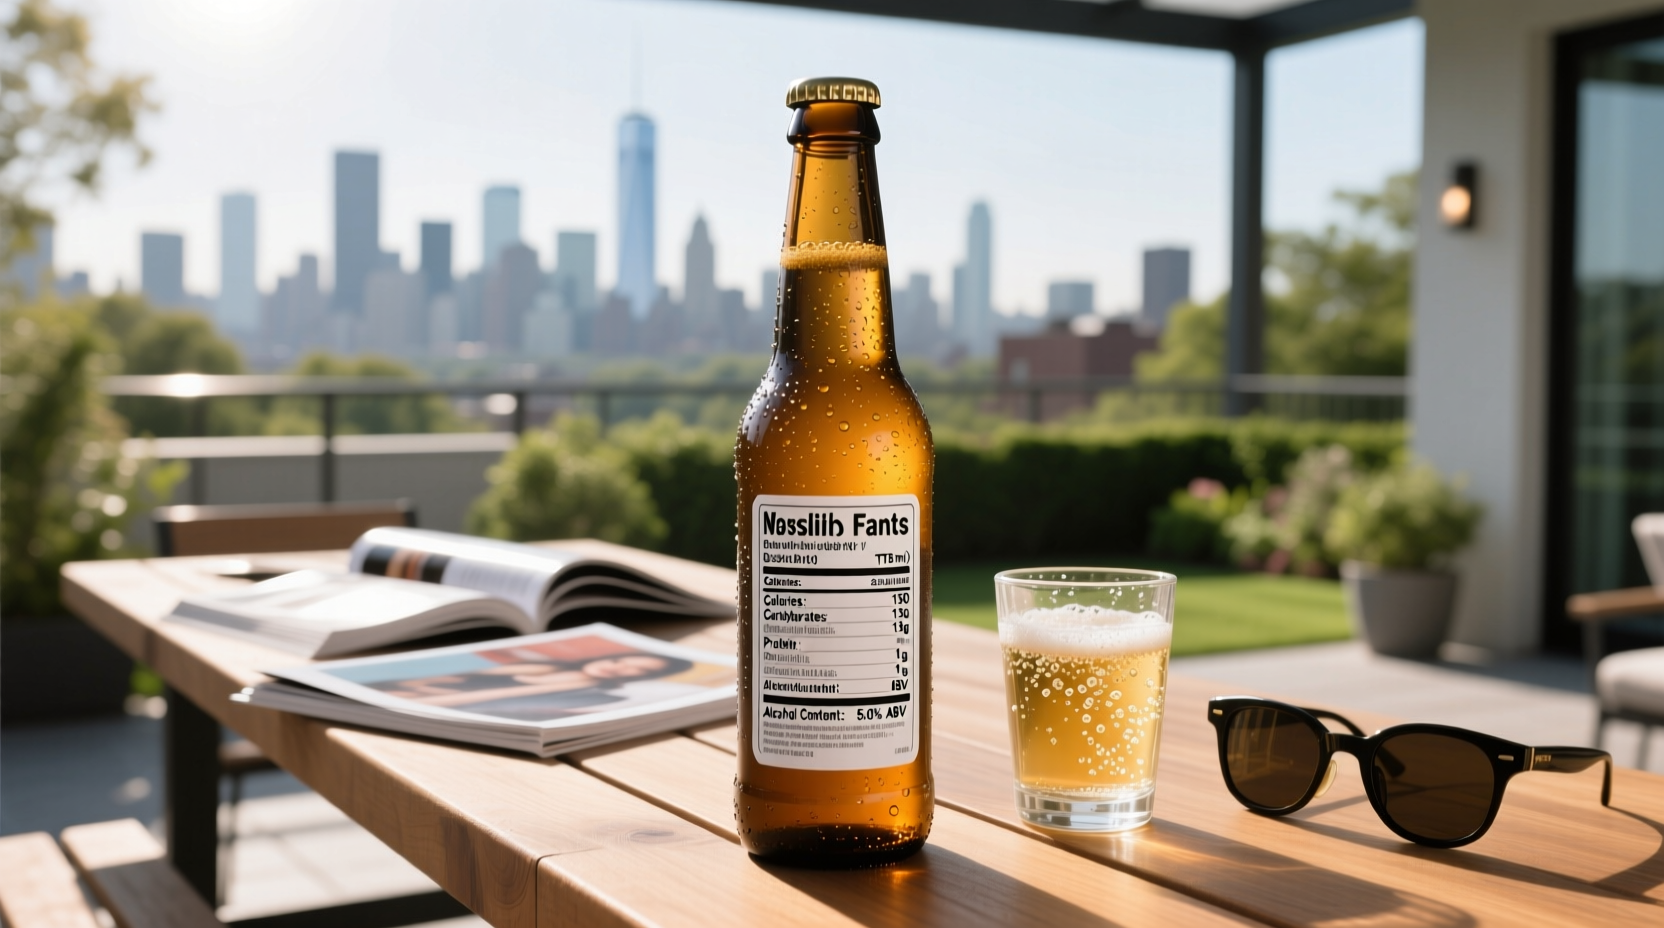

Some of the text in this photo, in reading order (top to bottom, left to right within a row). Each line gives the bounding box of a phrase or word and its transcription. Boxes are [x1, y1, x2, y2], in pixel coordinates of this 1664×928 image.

[853, 512, 909, 537] Fants
[856, 708, 883, 721] 5.0%
[886, 705, 907, 718] ABV
